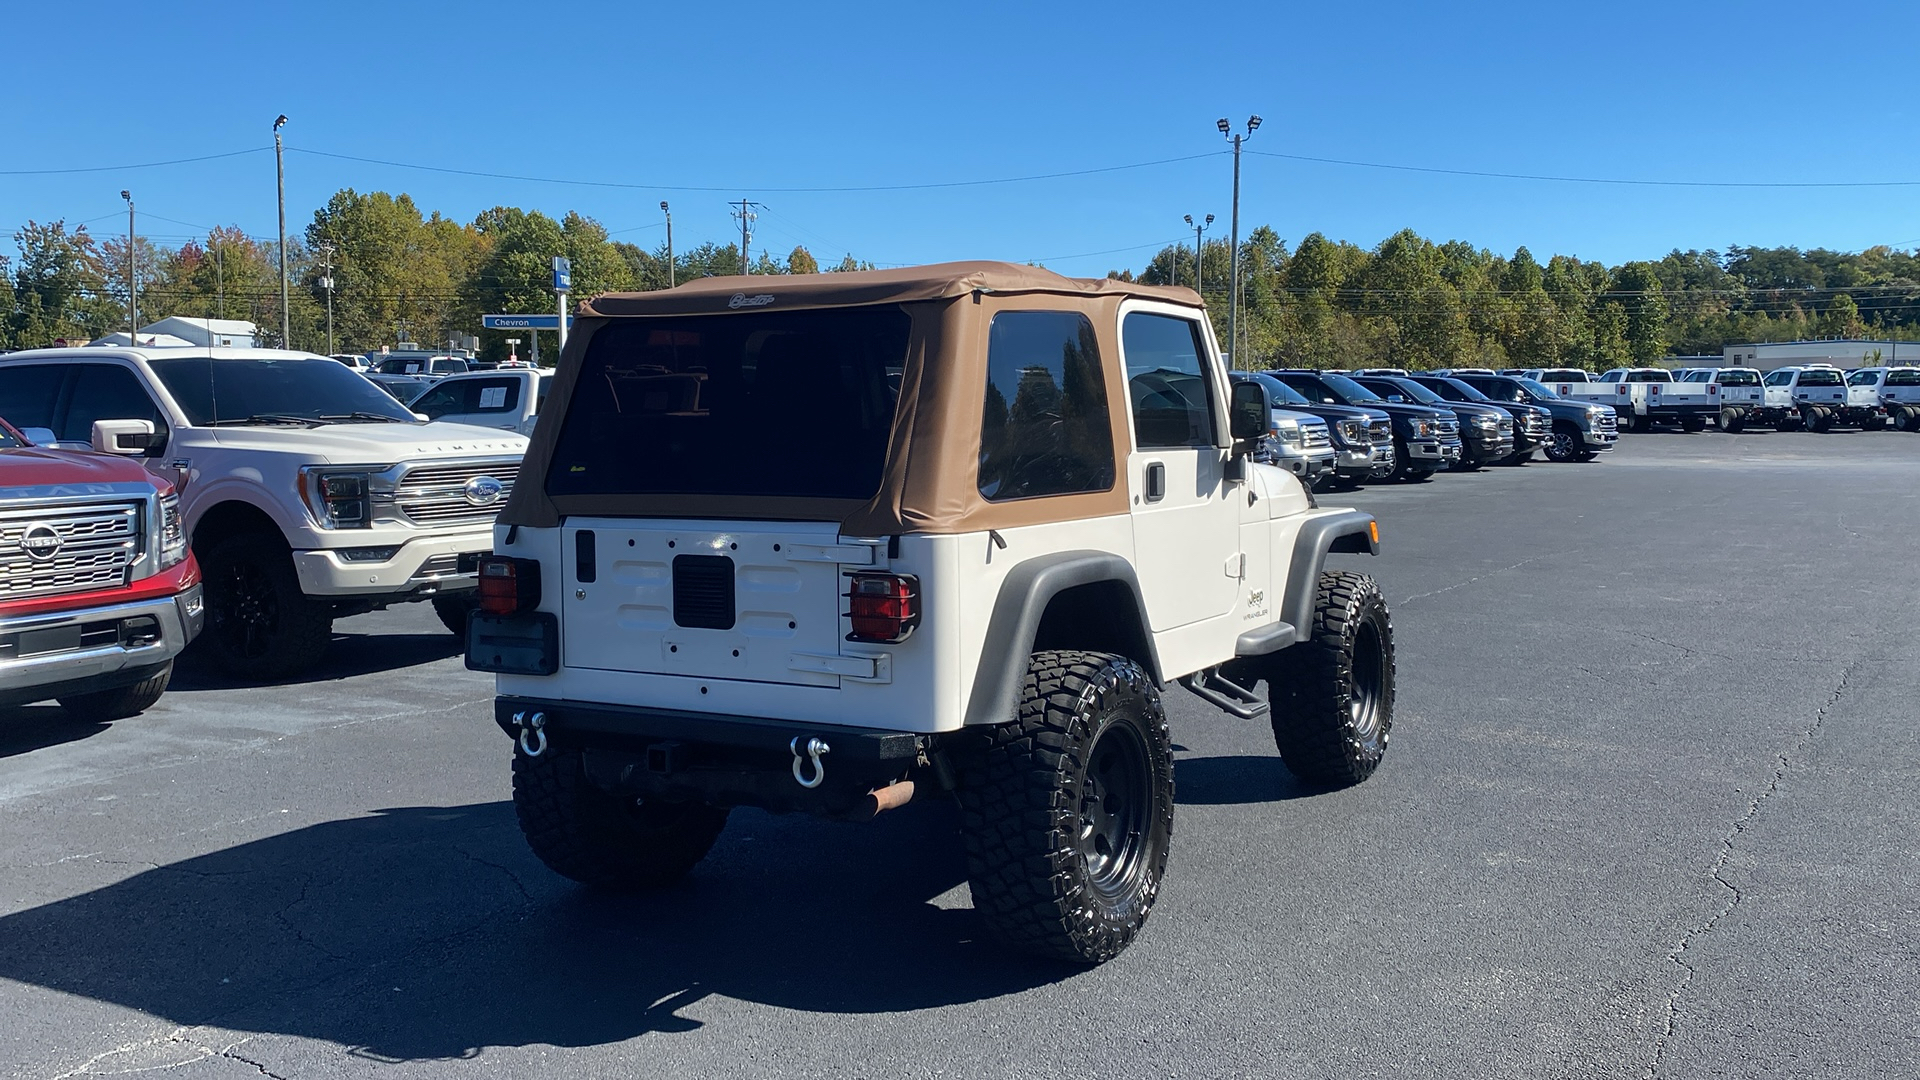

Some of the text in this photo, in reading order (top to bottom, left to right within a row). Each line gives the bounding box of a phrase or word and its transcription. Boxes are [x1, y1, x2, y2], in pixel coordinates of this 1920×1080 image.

[494, 318, 530, 326] Chevron
[417, 443, 523, 453] LIMITED
[20, 537, 65, 548] NISSAN
[1247, 589, 1264, 605] Jeep
[1242, 608, 1269, 621] WRANGLER
